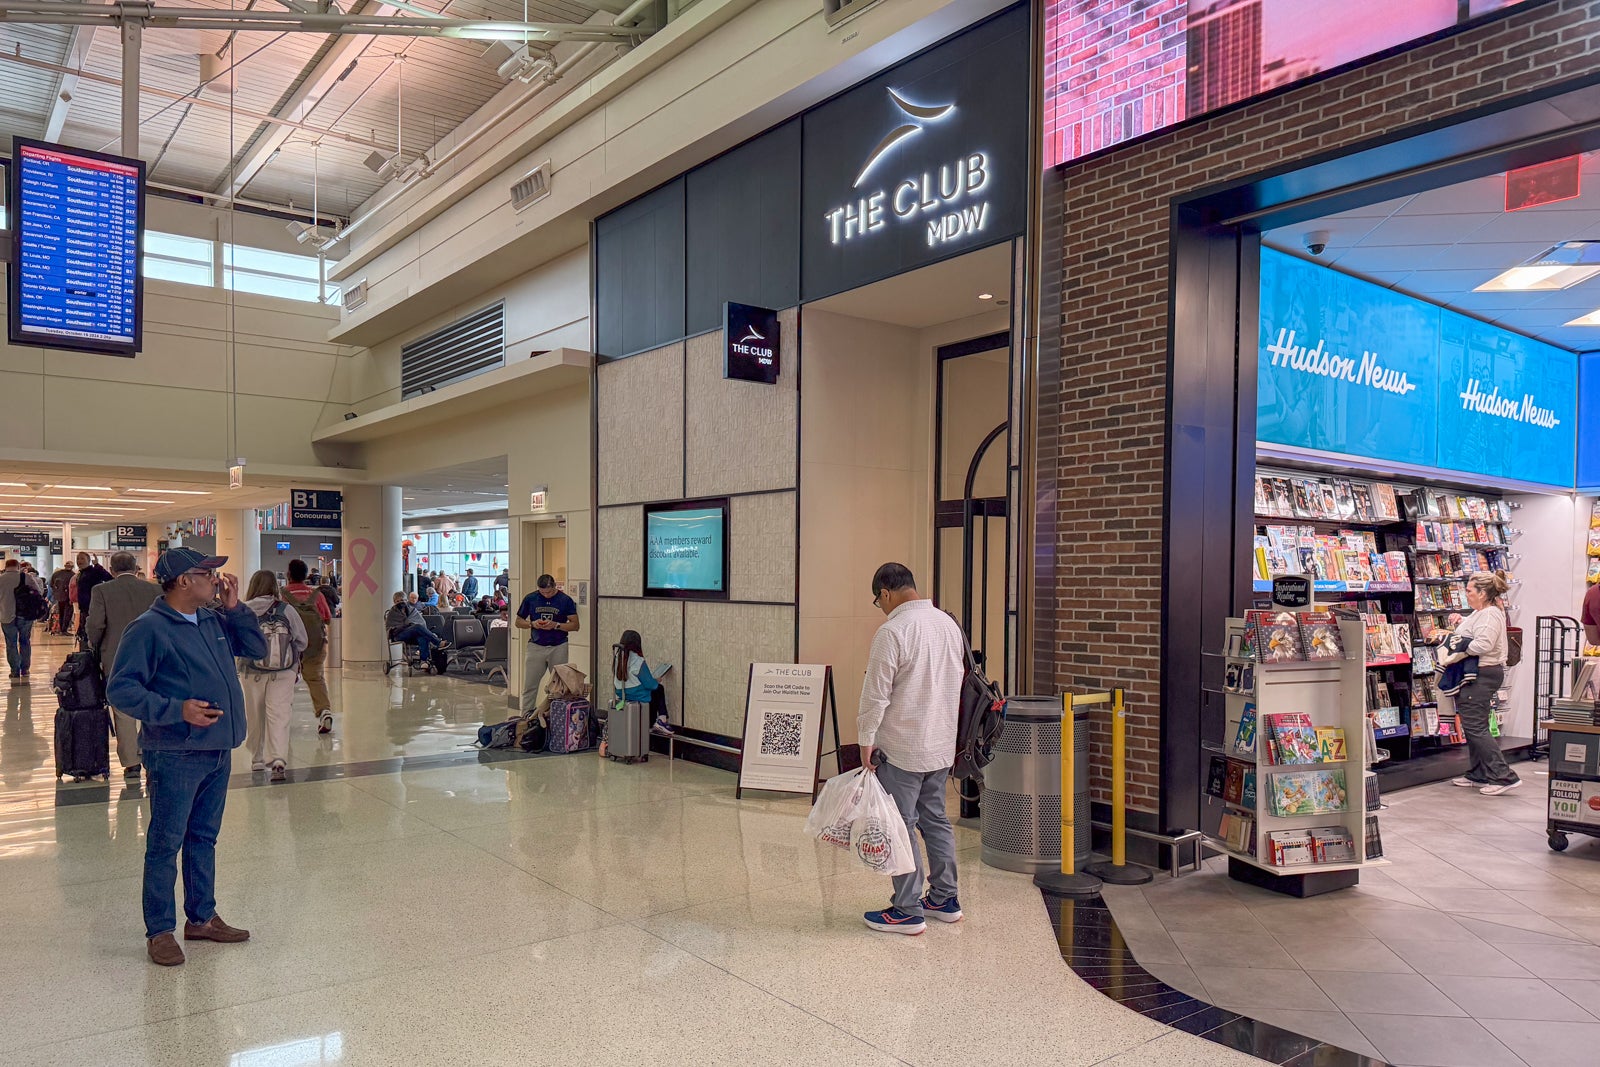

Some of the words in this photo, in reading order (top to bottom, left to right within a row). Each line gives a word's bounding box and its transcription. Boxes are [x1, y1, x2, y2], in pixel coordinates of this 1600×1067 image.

[68, 166, 94, 175] Southwest
[67, 176, 94, 185] Southwest
[67, 187, 94, 196] Southwest
[67, 197, 94, 206] Southwest
[824, 191, 887, 244] THE
[893, 152, 990, 217] CLUB
[67, 207, 94, 216] Southwest
[67, 218, 93, 227] Southwest
[927, 202, 989, 247] MDW
[67, 228, 93, 237] Southwest
[67, 238, 93, 247] Southwest
[67, 249, 93, 257] Southwest
[67, 259, 93, 267] Southwest
[66, 269, 93, 277] Southwest
[66, 279, 93, 287] Southwest
[732, 343, 750, 354] THE
[750, 346, 772, 358] CLUB
[1267, 328, 1357, 381] Hudson
[1355, 350, 1416, 395] News
[1460, 378, 1520, 421] Hudson
[1518, 393, 1560, 429] News
[293, 491, 318, 508] B1
[118, 527, 134, 536] B2
[664, 536, 690, 546] members
[691, 535, 712, 544] reward
[1322, 739, 1331, 760] A
[1333, 739, 1345, 760] Z
[1552, 790, 1580, 799] FOLLOW
[1554, 801, 1577, 813] YOU
